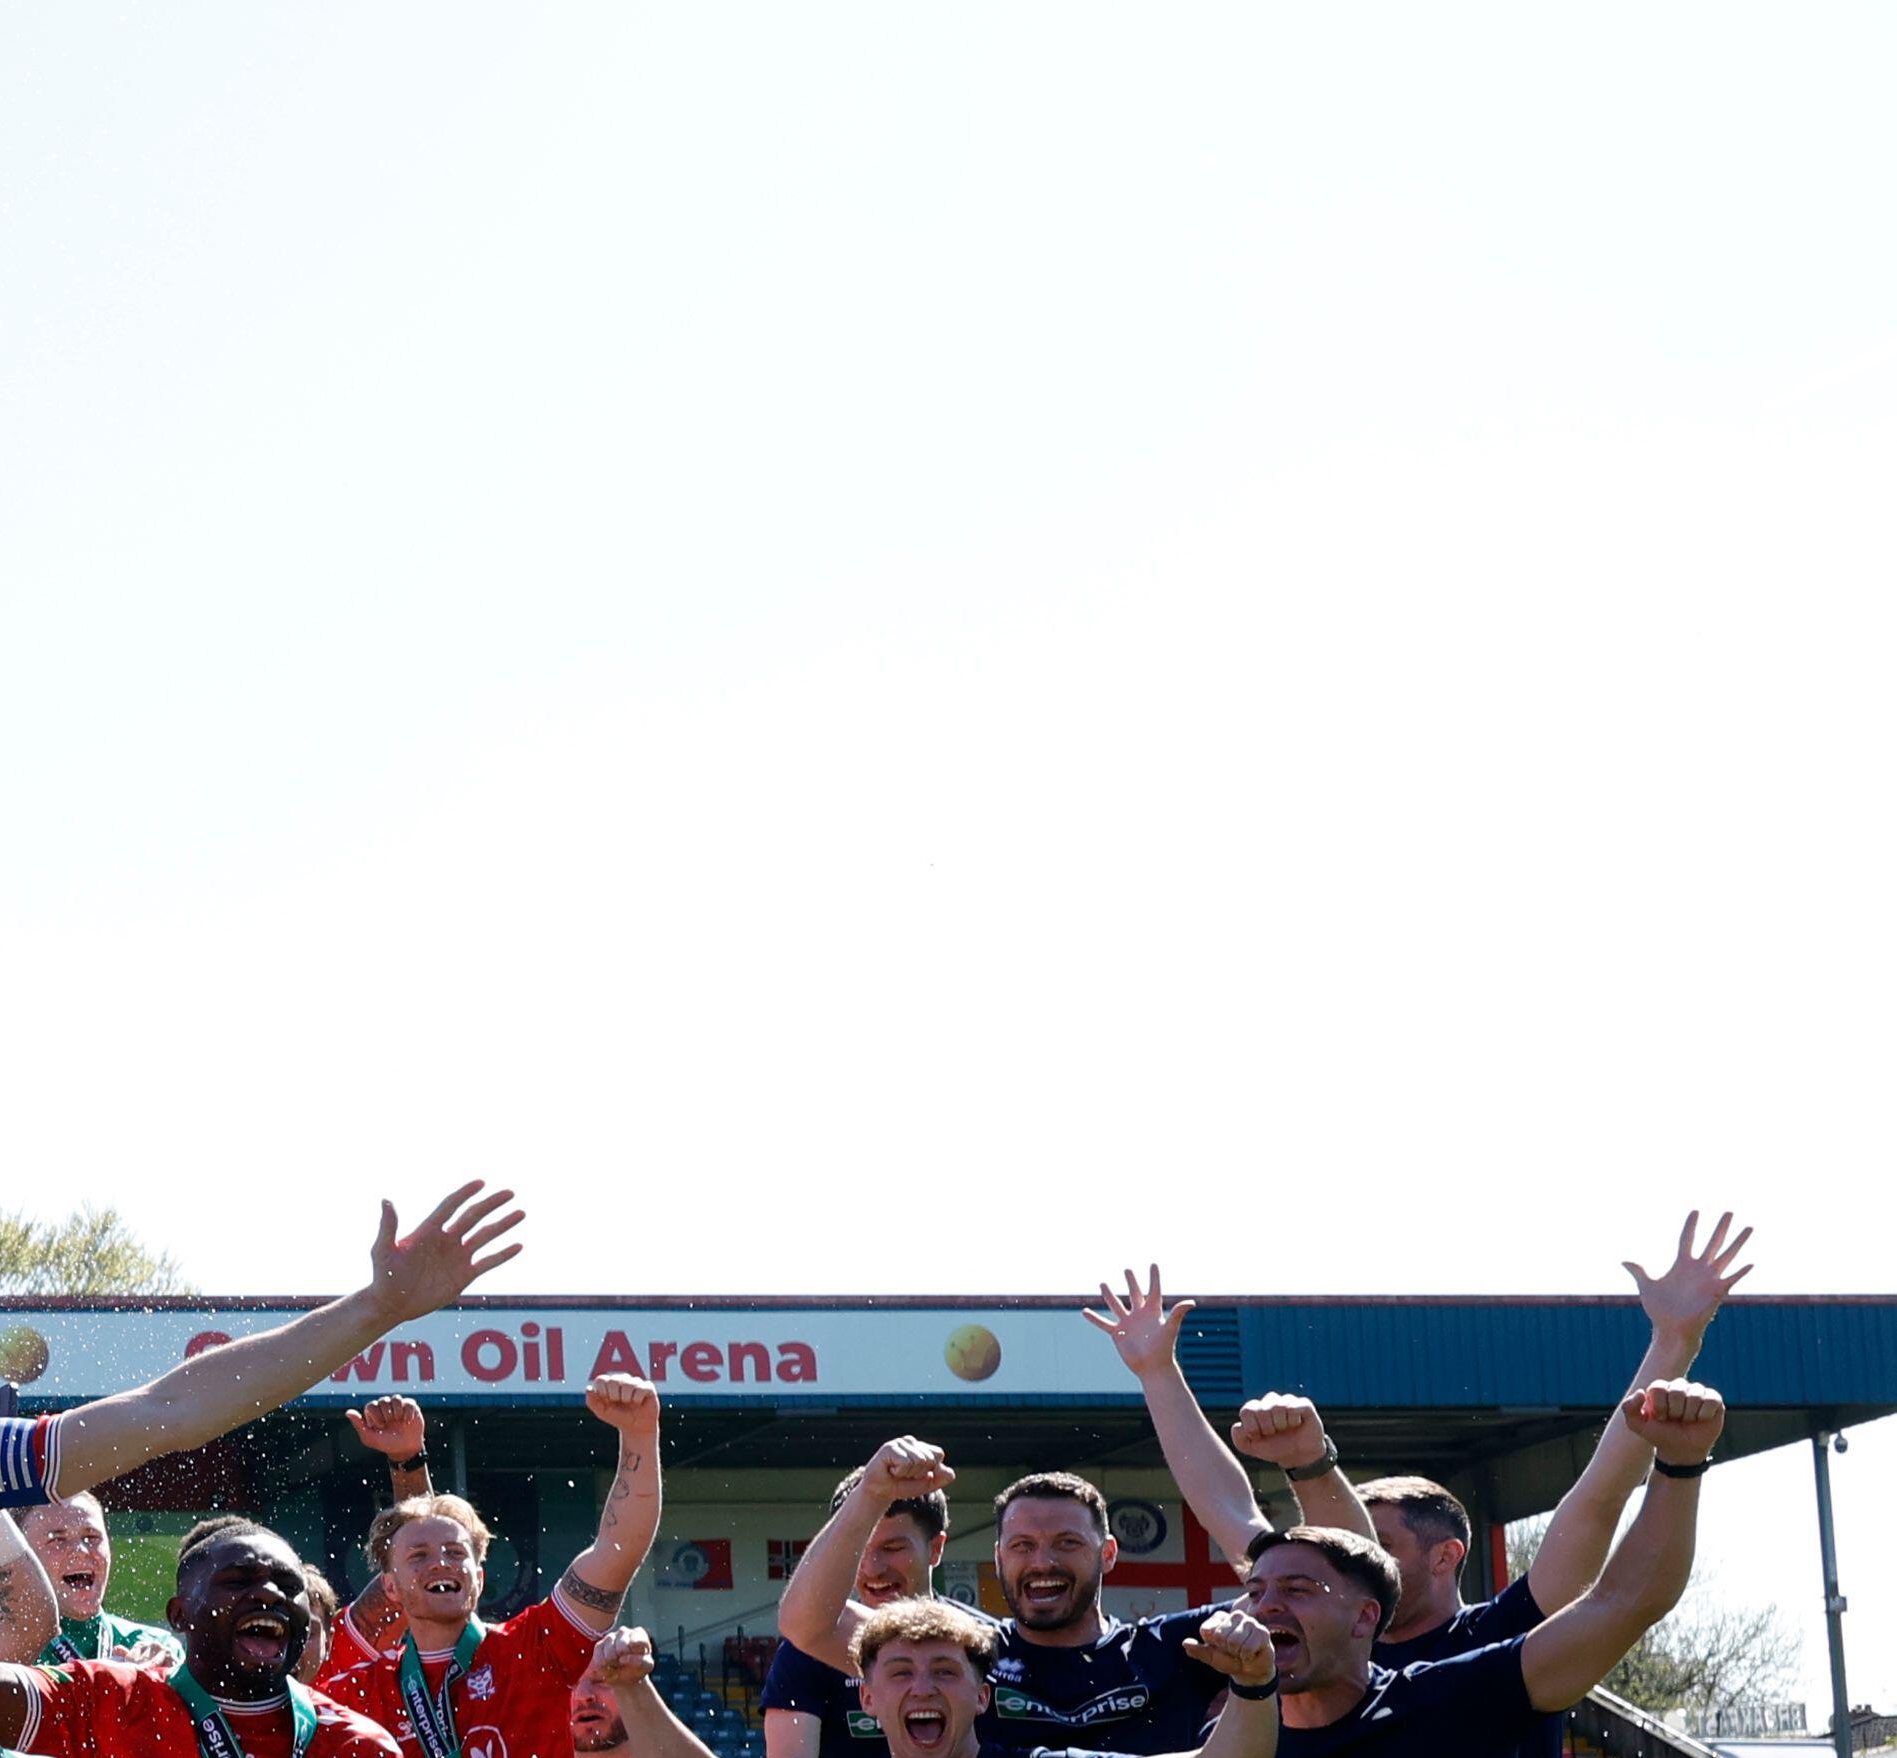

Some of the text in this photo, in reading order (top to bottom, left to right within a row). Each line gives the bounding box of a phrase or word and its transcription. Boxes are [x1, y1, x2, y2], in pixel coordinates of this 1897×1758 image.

[460, 1321, 565, 1384] Oil
[588, 1330, 818, 1383] Arena
[997, 1692, 1147, 1726] enterprise
